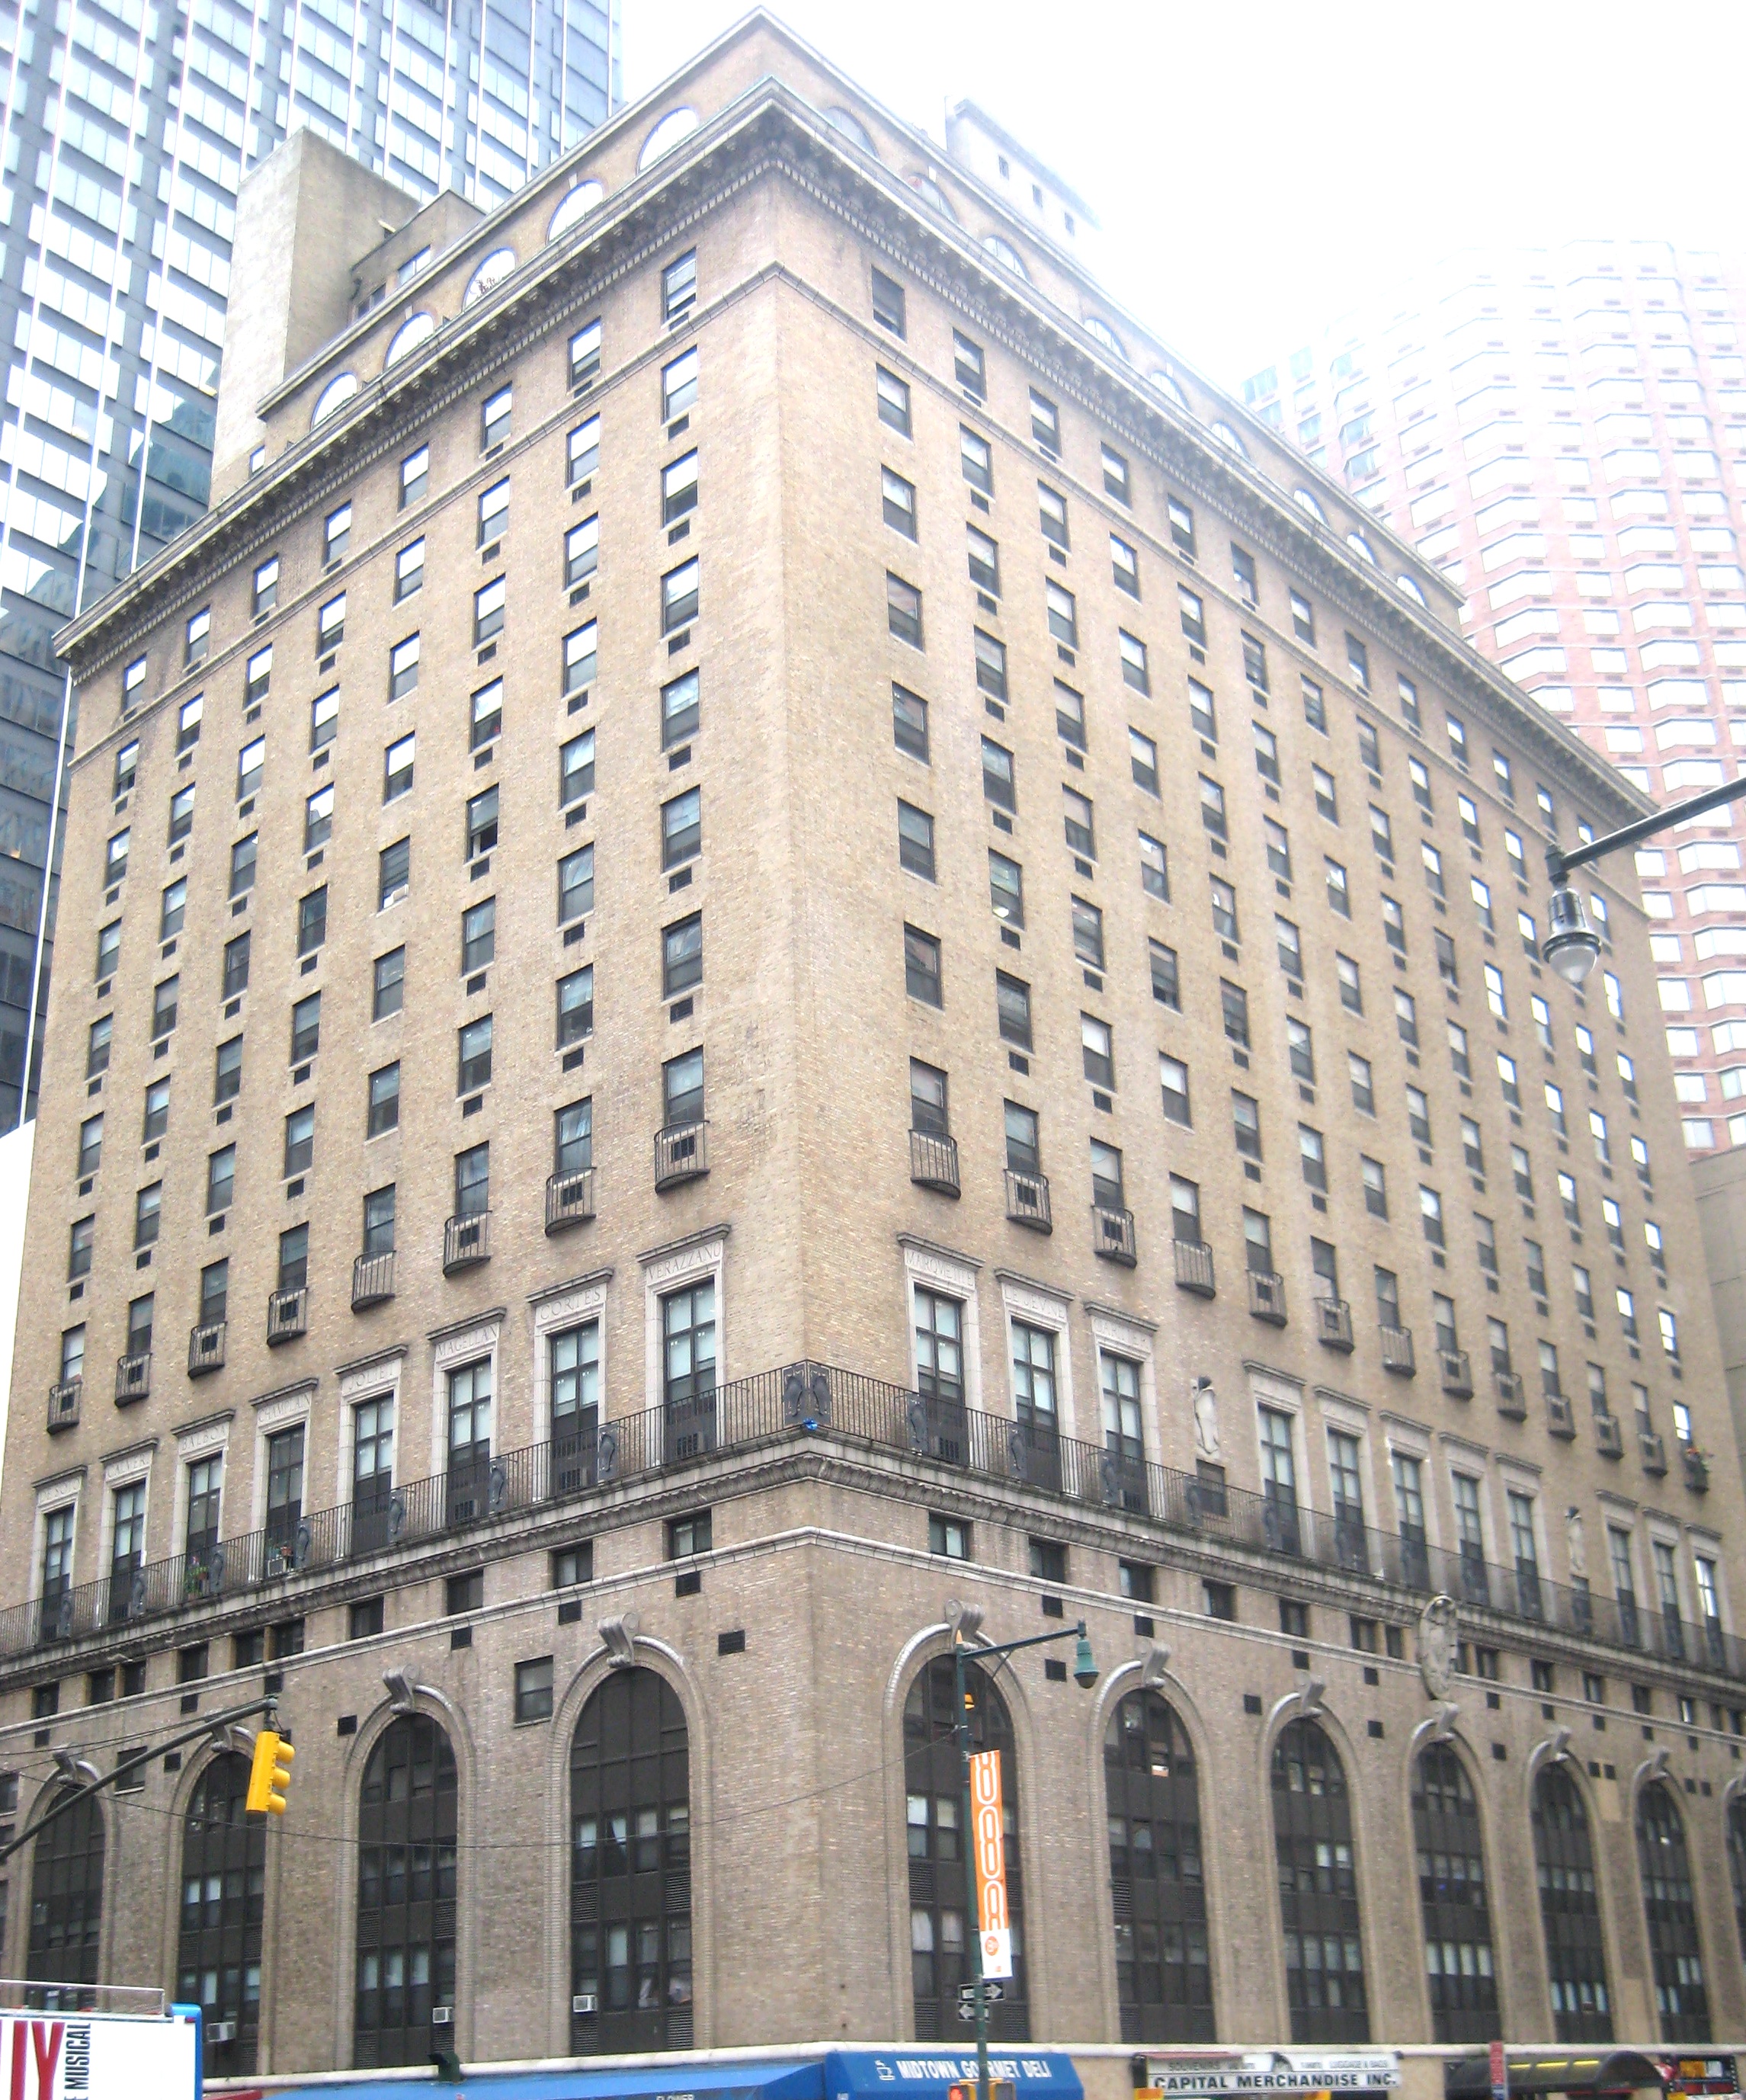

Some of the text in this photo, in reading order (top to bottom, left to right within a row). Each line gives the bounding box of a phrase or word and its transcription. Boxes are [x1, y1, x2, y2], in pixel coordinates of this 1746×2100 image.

[649, 1242, 722, 1281] VERAZZANO
[540, 1287, 601, 1319] CORTES
[437, 1323, 498, 1355] MAGELLAN
[348, 1361, 396, 1390] JOLIET
[181, 1424, 226, 1451] BALBOA
[64, 2023, 91, 2089] MUSICAL
[895, 2060, 1052, 2079] MIDTOWN GORMET DELI
[1155, 2073, 1396, 2089] CAPITAL MERCHANDISE INC.
